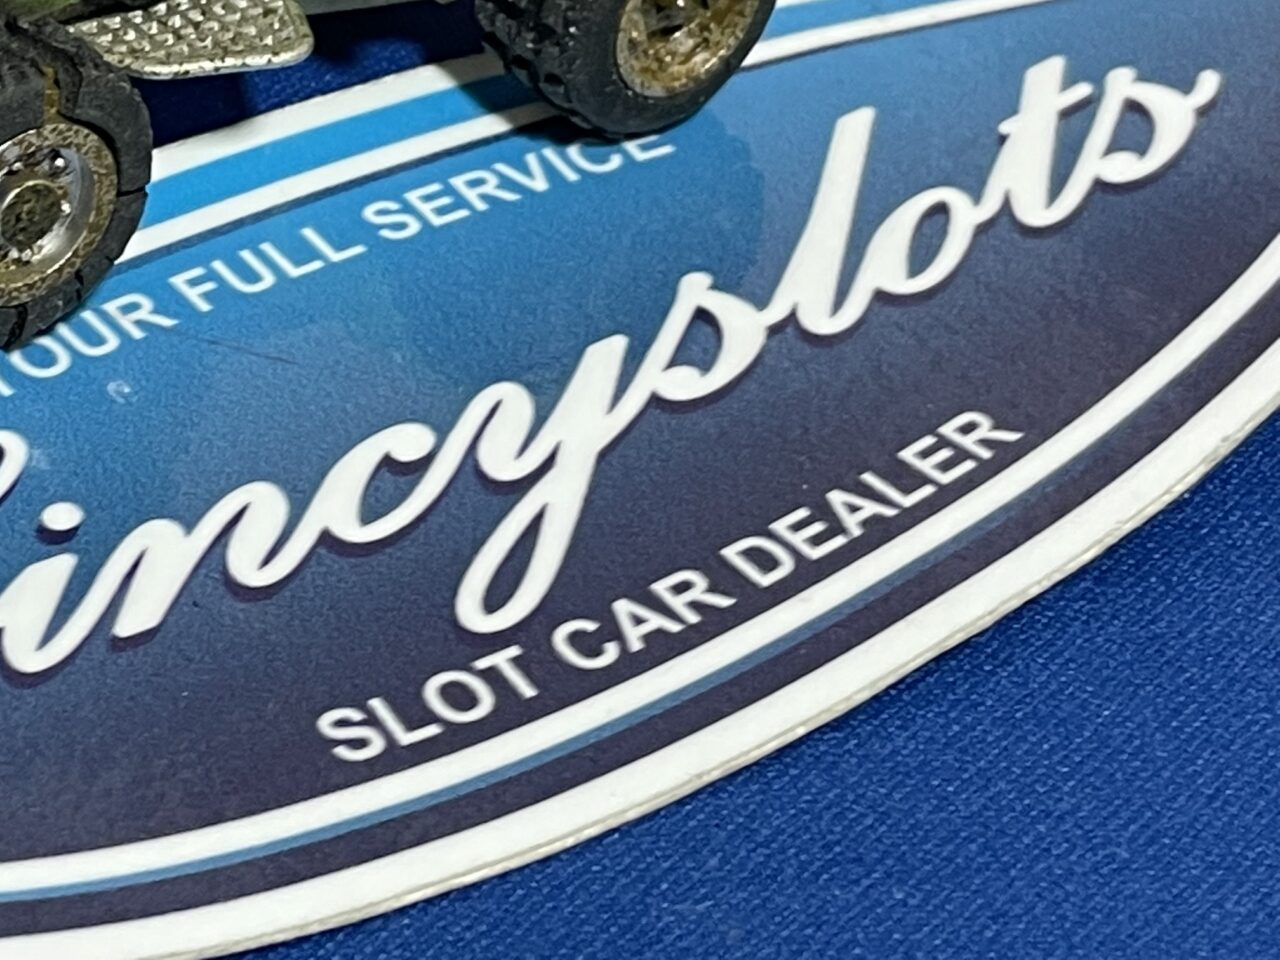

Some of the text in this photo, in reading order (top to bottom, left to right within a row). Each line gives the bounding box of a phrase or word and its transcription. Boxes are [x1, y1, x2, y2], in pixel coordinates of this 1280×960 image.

[168, 226, 366, 312] FULL
[363, 134, 676, 263] SERVICE
[316, 410, 1025, 762] SLOT CAR DEALER
